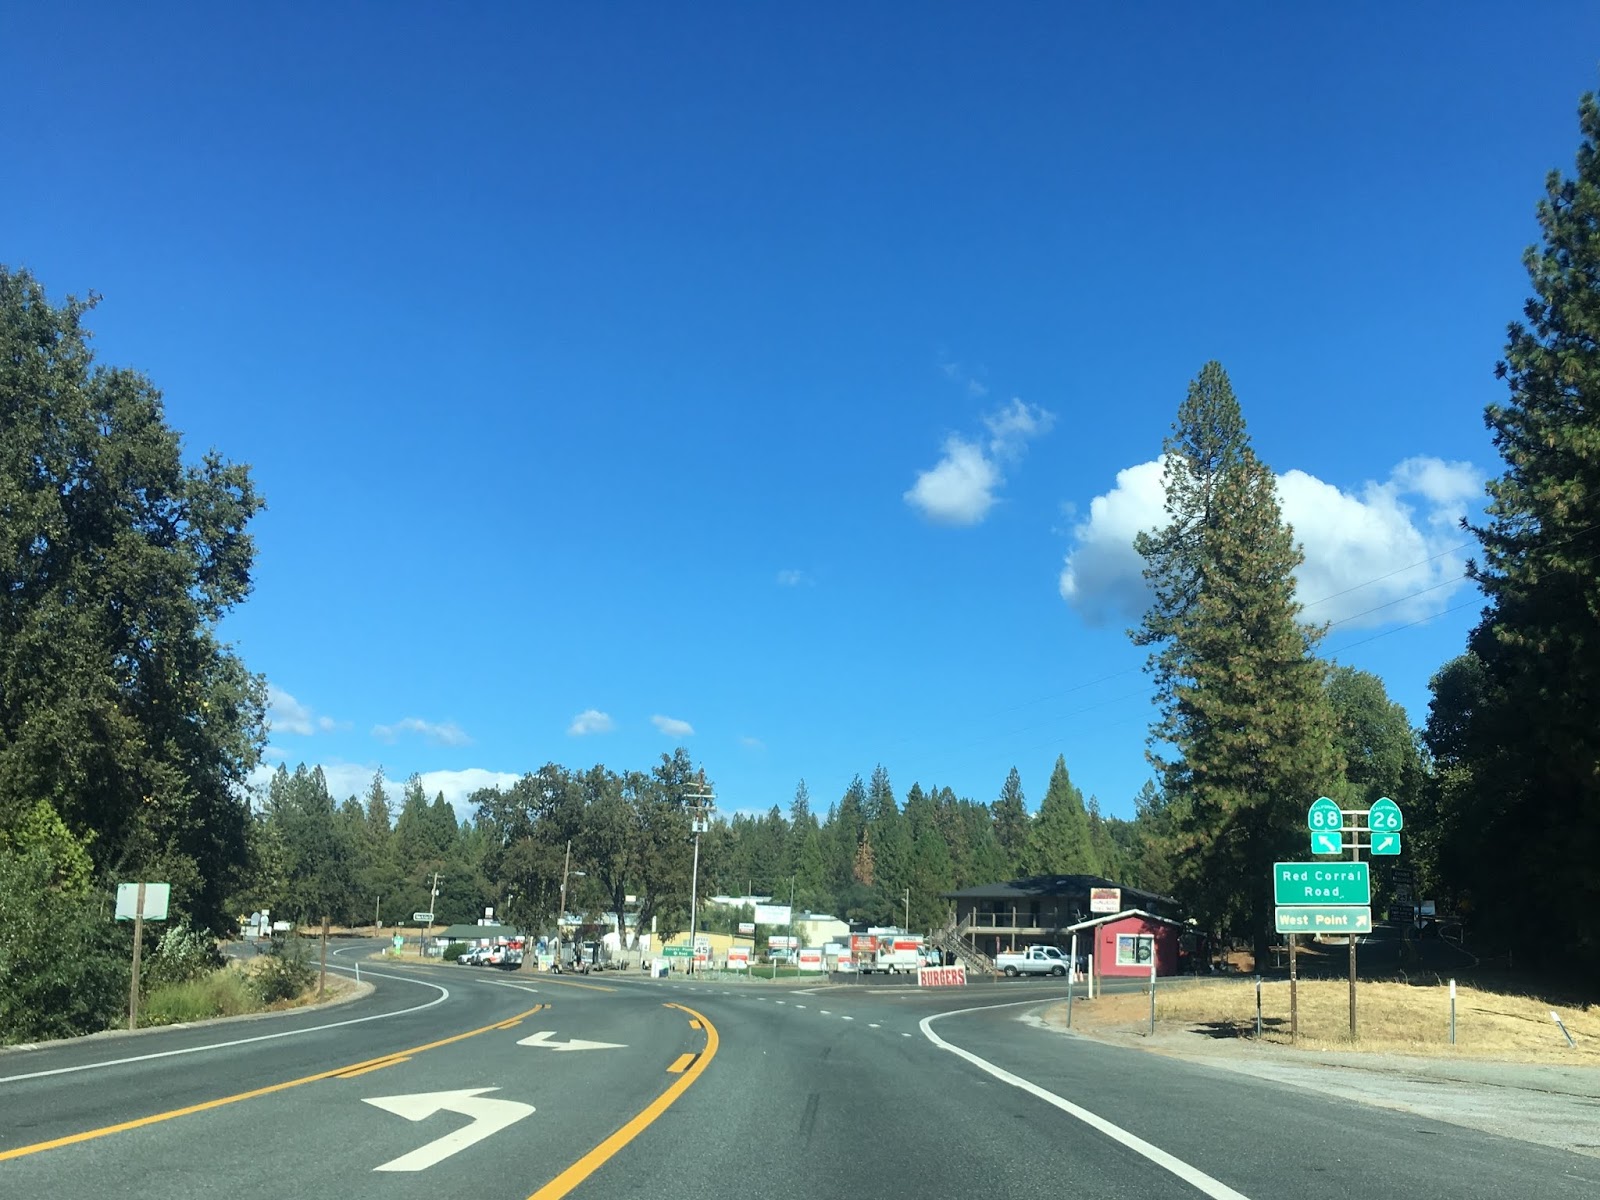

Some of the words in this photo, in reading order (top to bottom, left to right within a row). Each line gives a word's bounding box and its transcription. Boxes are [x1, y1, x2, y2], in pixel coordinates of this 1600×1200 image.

[1313, 810, 1338, 827] 88
[1373, 811, 1398, 828] 26
[1282, 871, 1308, 881] Red
[1314, 870, 1361, 881] Corral
[1304, 886, 1340, 897] Road
[1279, 914, 1309, 925] West
[1315, 914, 1348, 925] Point
[695, 946, 708, 954] 45
[920, 967, 965, 986] BURGERS
